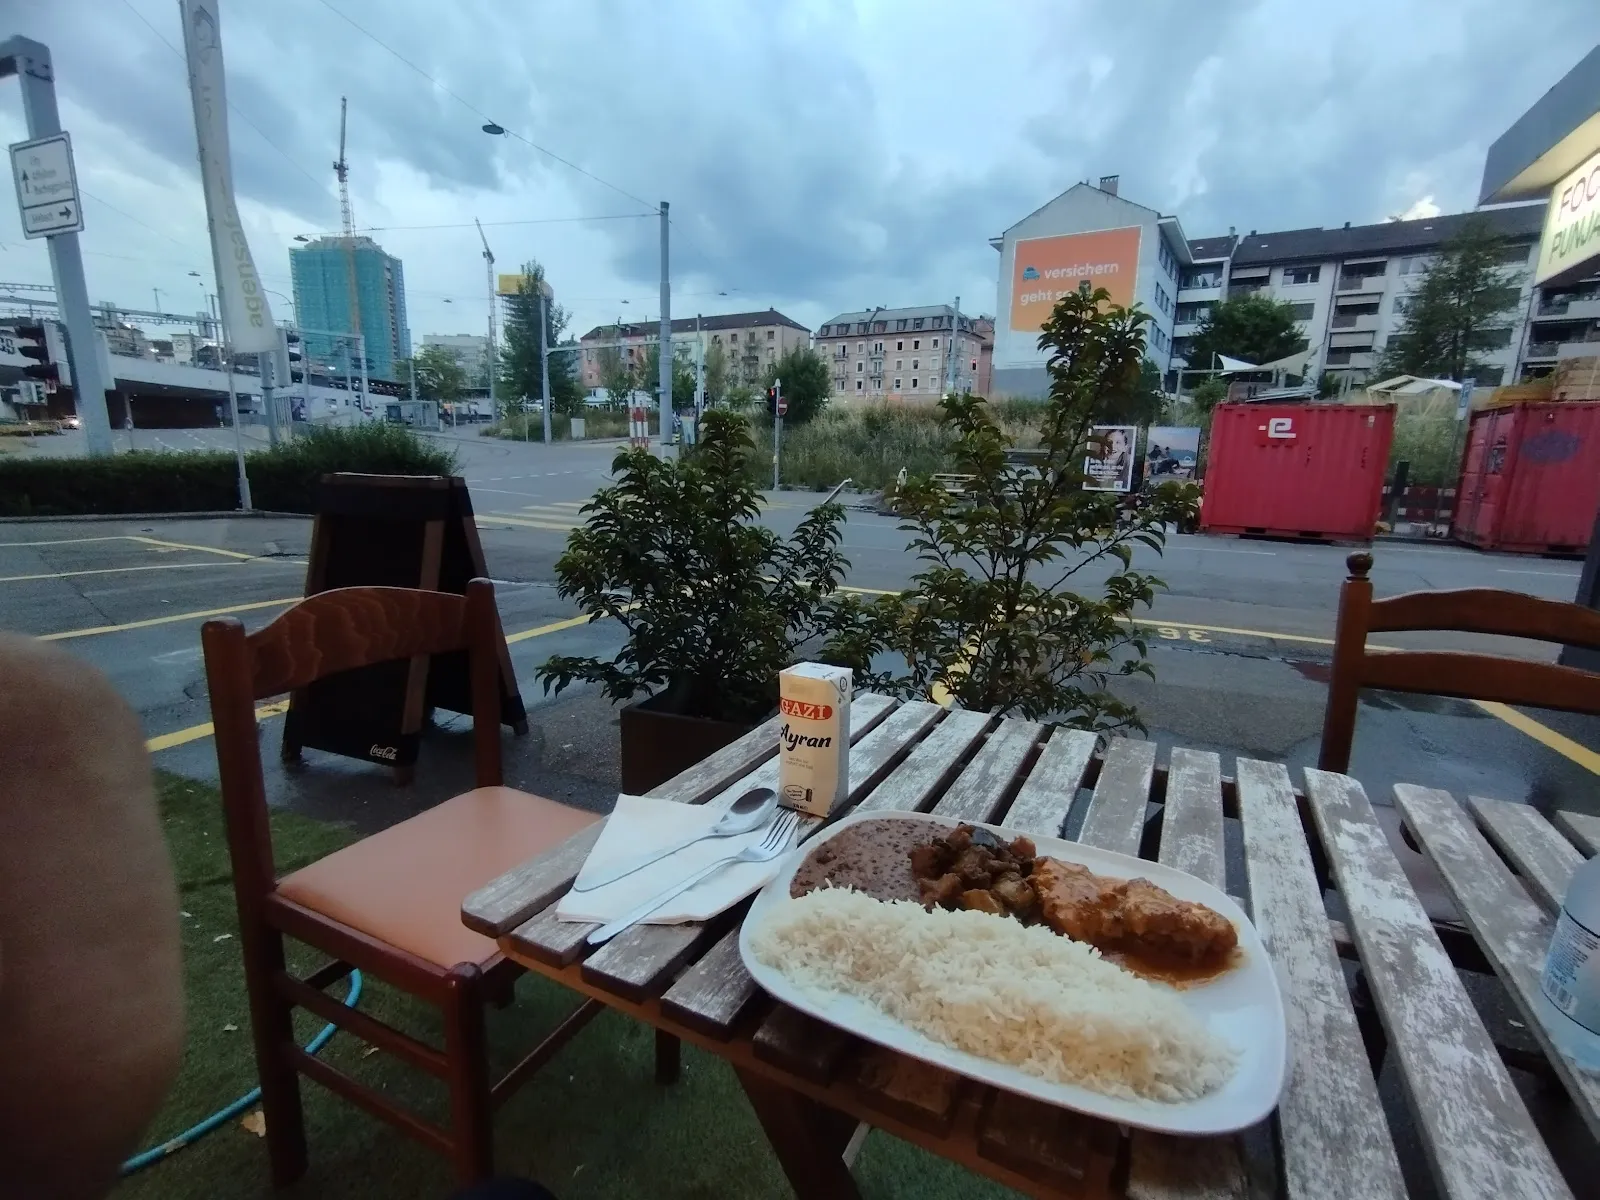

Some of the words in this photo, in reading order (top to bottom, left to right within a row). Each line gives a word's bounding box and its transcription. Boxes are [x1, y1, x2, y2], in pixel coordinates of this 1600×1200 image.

[1044, 262, 1119, 279] versichern
[1020, 289, 1052, 306] geht
[780, 700, 827, 720] GAZI
[780, 723, 832, 752] Ayran
